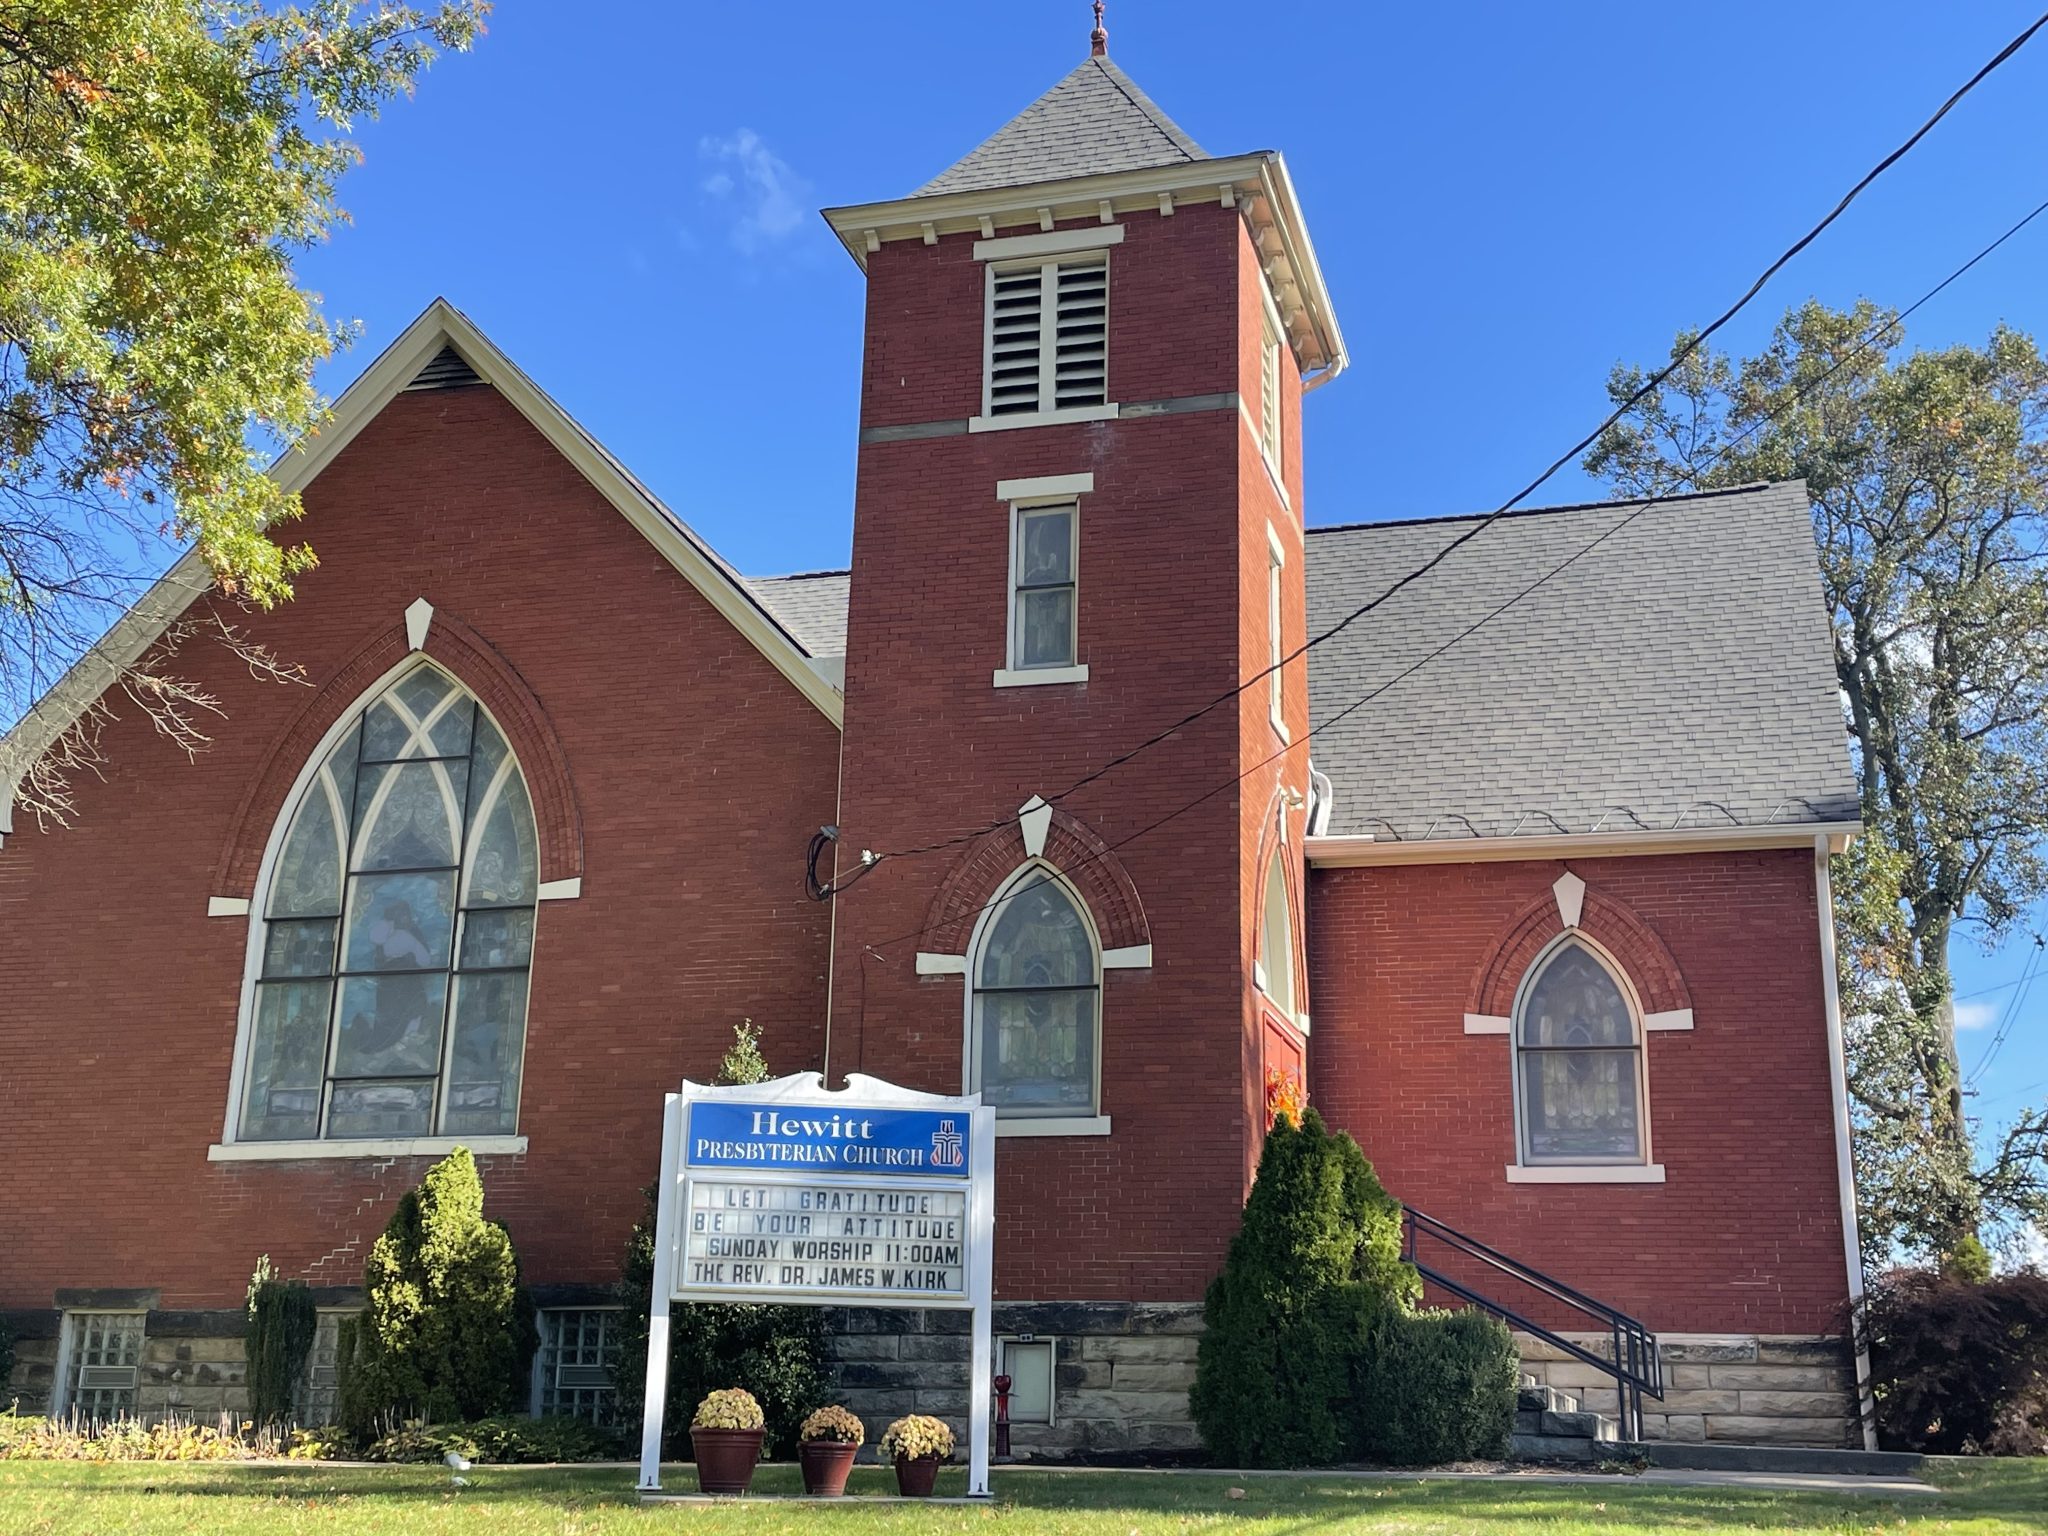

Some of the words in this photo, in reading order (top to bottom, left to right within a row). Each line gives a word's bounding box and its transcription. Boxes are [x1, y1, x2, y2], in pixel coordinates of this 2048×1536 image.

[751, 1111, 874, 1139] Hewitt
[695, 1138, 838, 1162] PRESBYTERIAN
[843, 1145, 924, 1166] CHURCH
[728, 1188, 766, 1208] LET
[800, 1191, 929, 1214] GRATITUDE
[695, 1213, 722, 1232] BE
[756, 1214, 811, 1235] YOUR
[844, 1217, 955, 1240] ATTITUDE
[709, 1237, 779, 1259] SUNDAY
[792, 1241, 873, 1262] WORSHIP
[732, 1264, 772, 1285] REV.
[781, 1266, 811, 1285] DR.
[818, 1267, 875, 1287] JAMES
